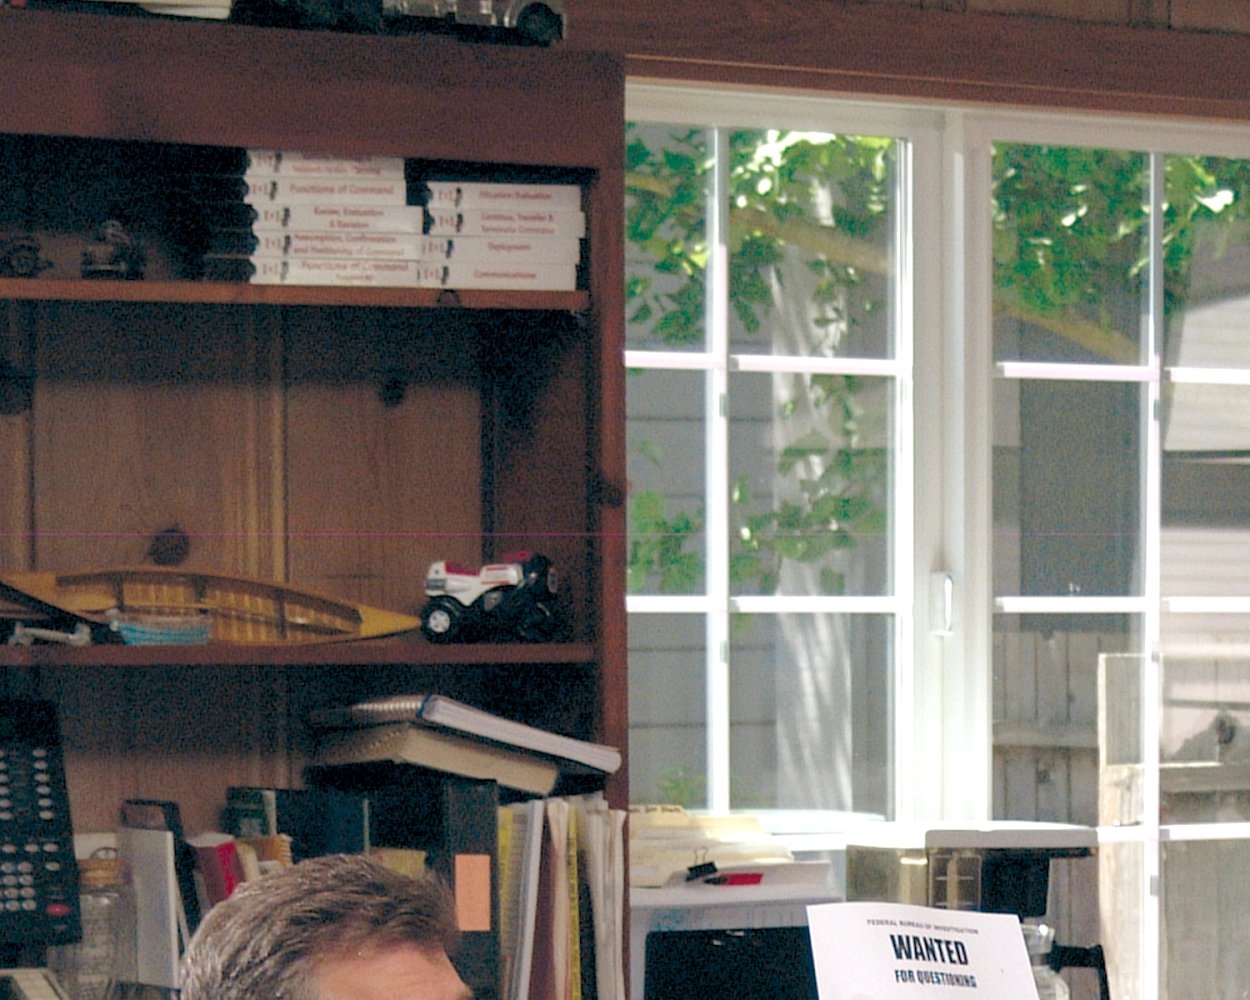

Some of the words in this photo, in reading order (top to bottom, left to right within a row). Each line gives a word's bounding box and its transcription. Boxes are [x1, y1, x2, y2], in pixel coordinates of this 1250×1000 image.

[866, 919, 898, 927] FEDERAL
[899, 921, 924, 929] BUREAU
[889, 934, 969, 966] WANTED
[894, 969, 916, 984] FOR
[916, 970, 978, 989] QUESTIONING
